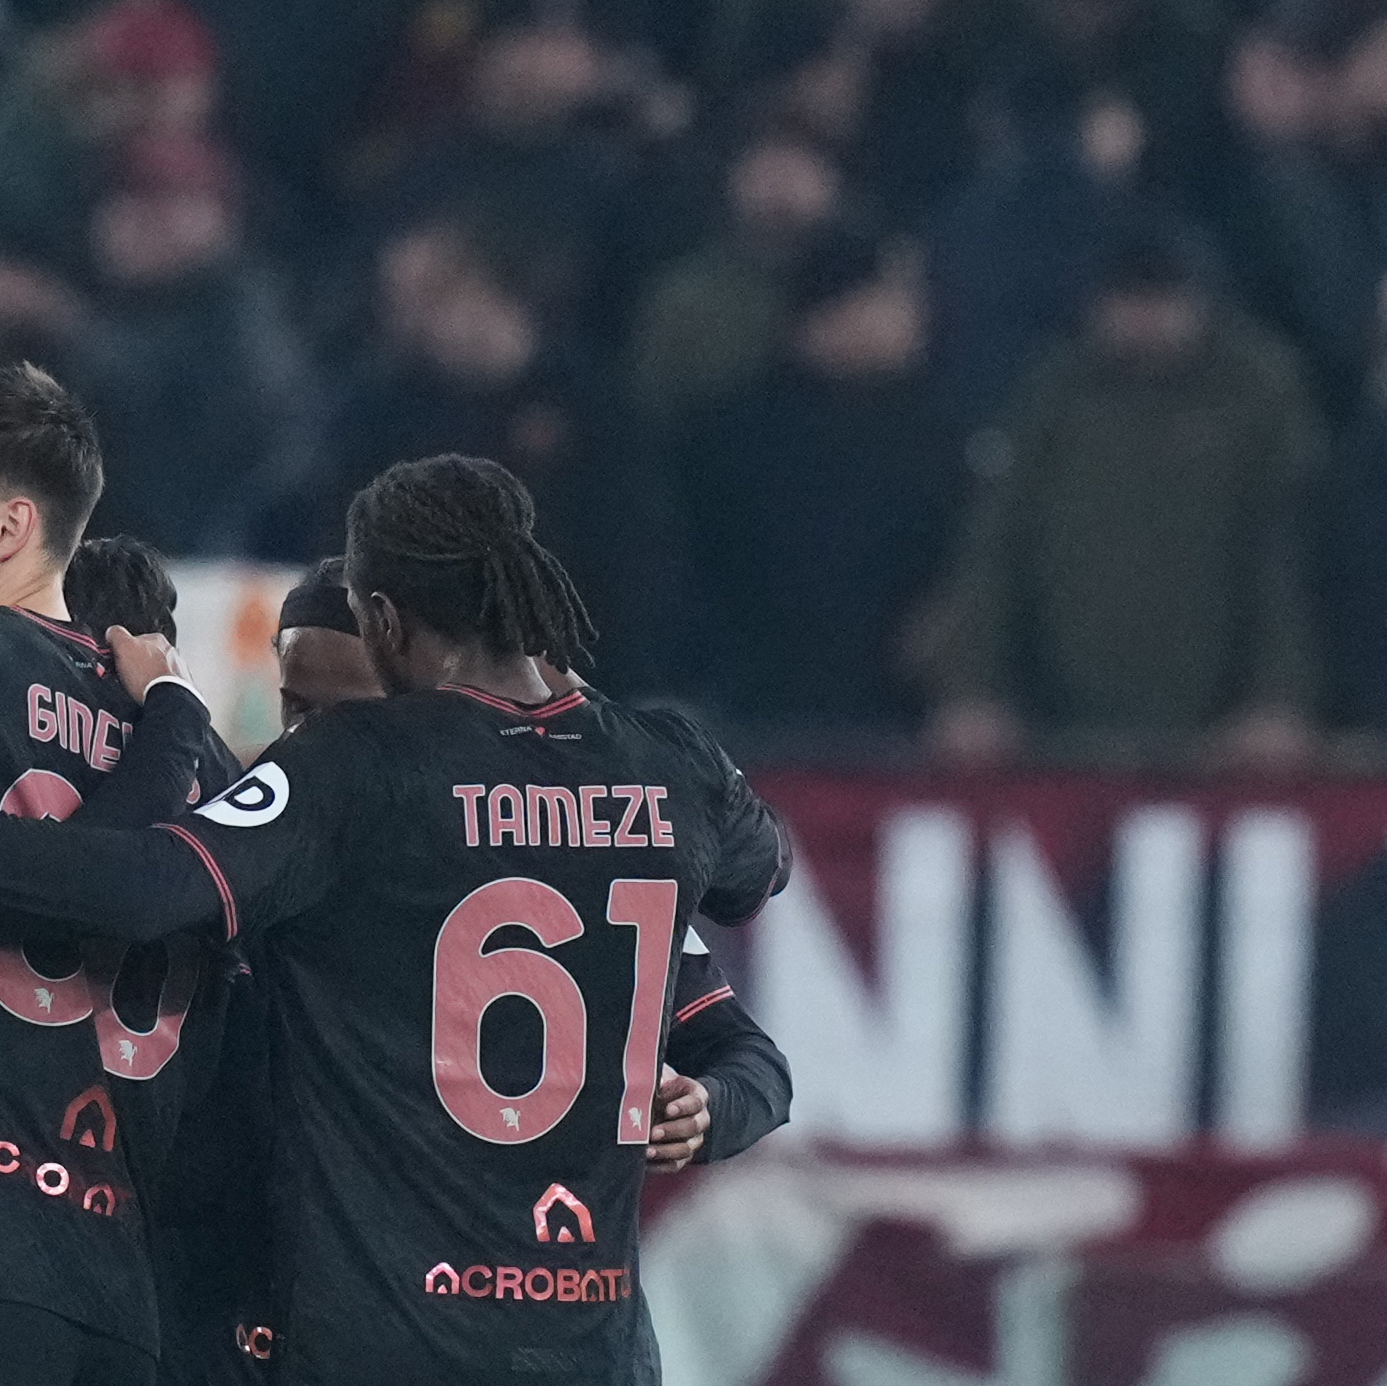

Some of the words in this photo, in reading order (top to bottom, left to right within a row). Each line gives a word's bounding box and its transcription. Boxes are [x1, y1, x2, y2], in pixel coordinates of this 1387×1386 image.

[28, 683, 133, 773] GINE
[452, 784, 675, 848] TAMEZE
[431, 877, 678, 1145] 61
